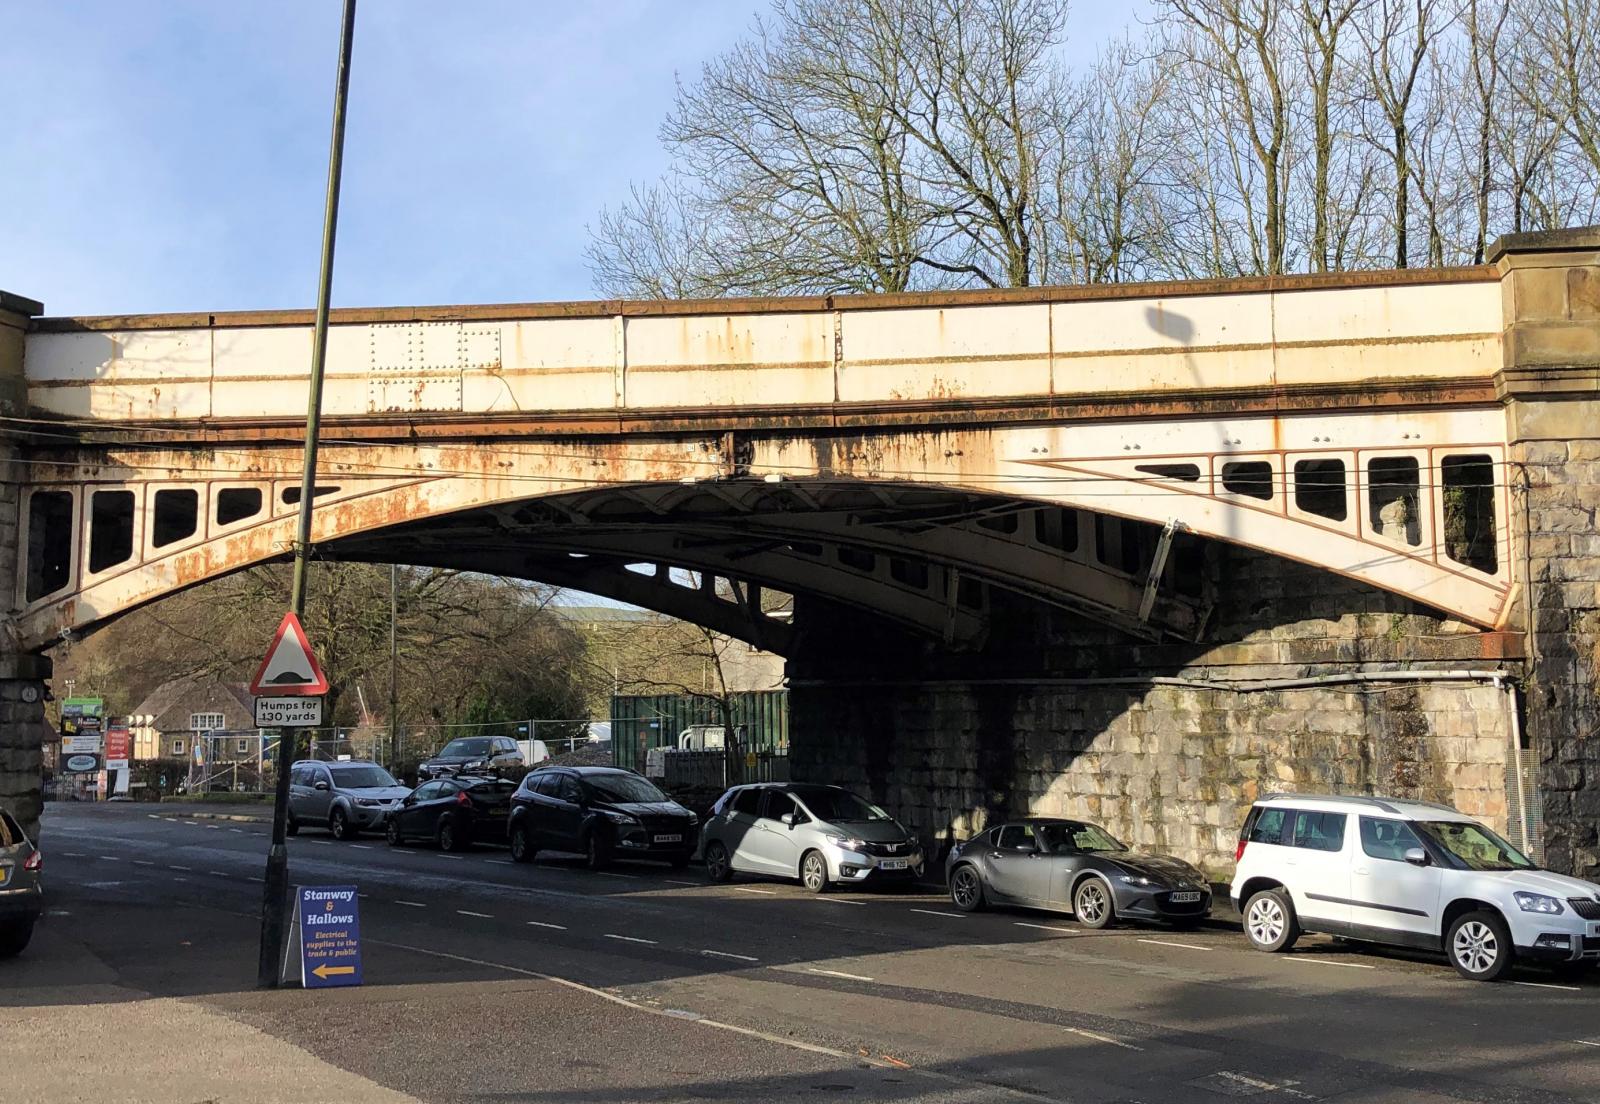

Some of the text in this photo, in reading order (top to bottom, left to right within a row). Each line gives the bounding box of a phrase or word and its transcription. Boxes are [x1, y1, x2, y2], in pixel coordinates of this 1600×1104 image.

[260, 700, 317, 711] Humps for
[262, 712, 316, 722] 130 yards
[304, 890, 354, 902] Stanway
[1173, 892, 1188, 901] MA69
[326, 901, 334, 911] &
[307, 914, 353, 924] Hallows
[306, 941, 335, 949] supplies
[335, 948, 357, 957] public
